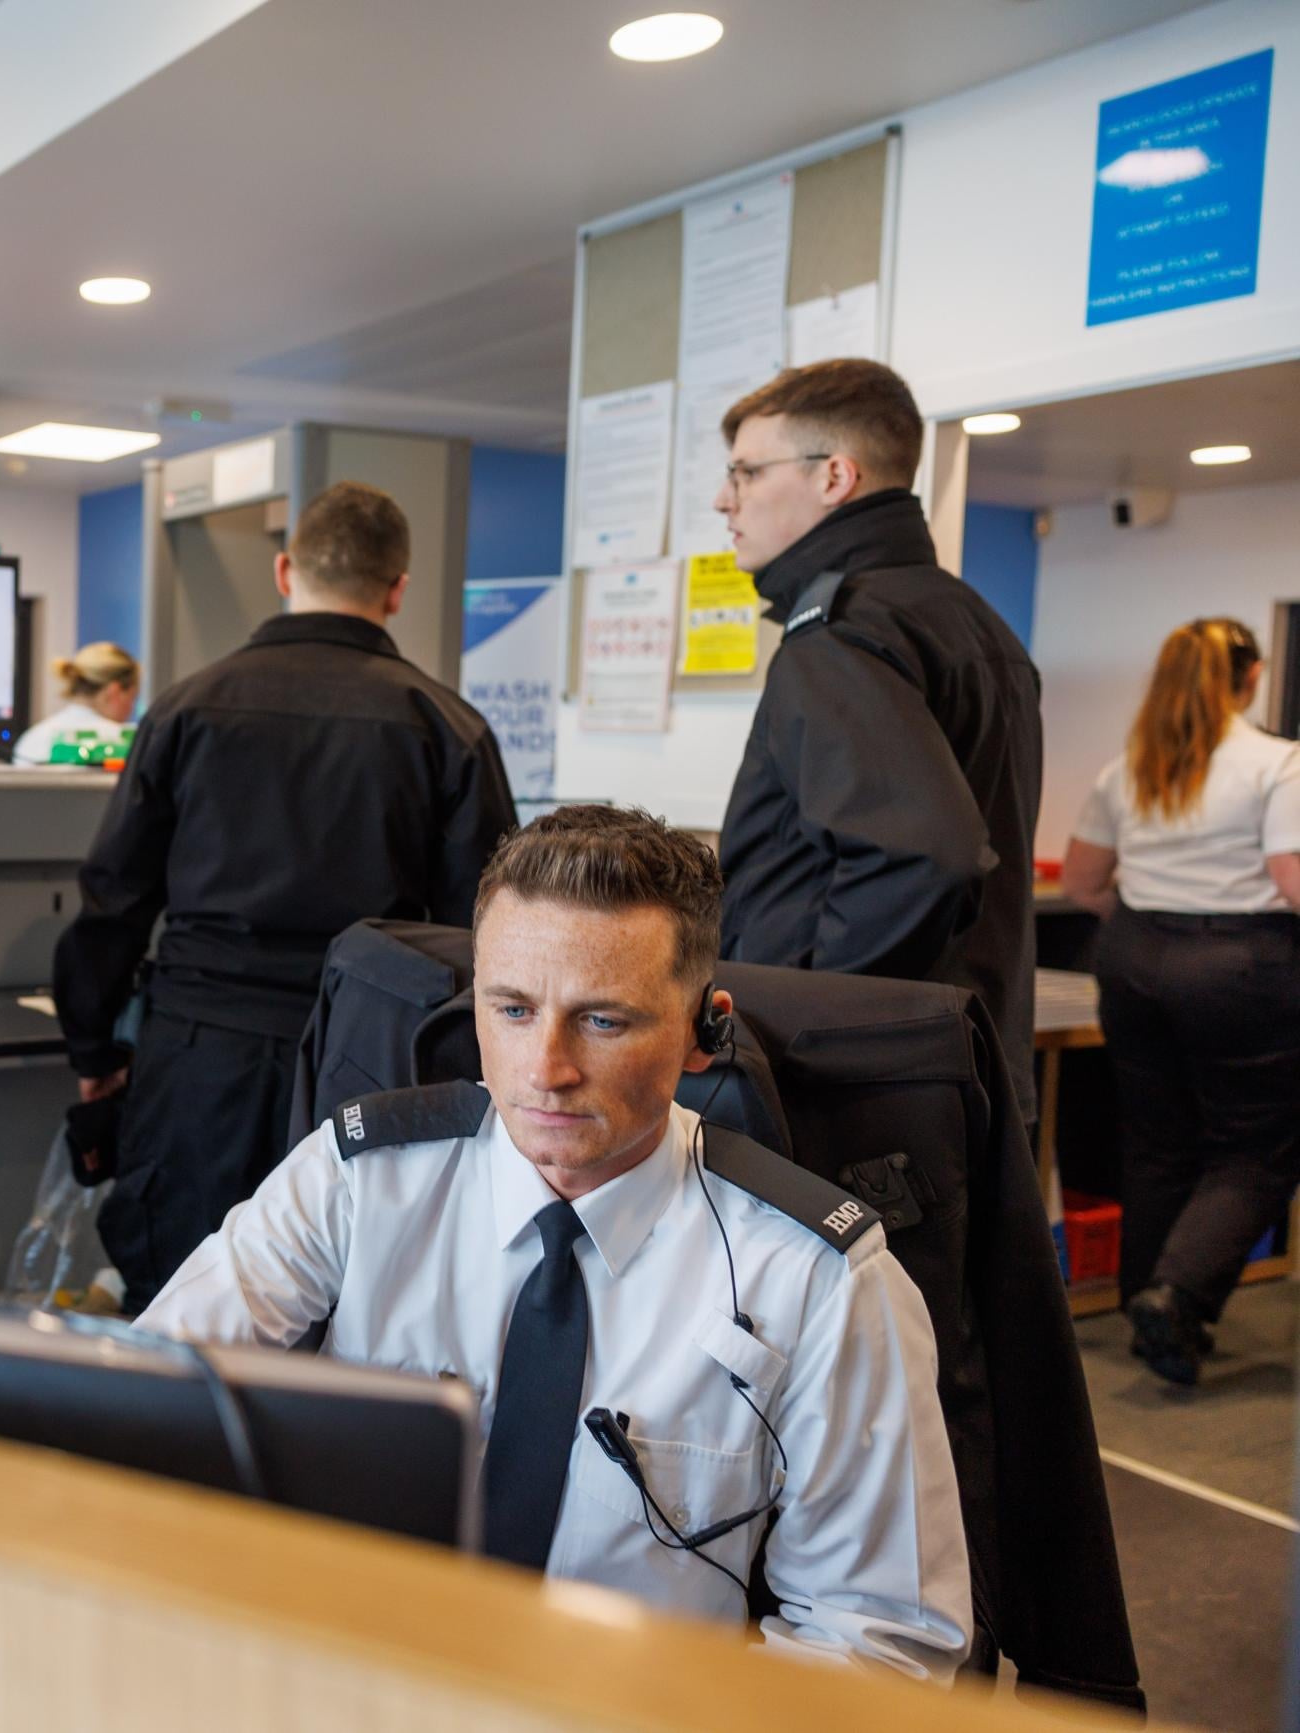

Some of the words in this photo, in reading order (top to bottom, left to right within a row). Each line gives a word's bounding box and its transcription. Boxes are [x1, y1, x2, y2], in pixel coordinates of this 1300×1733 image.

[468, 681, 552, 701] WASH
[343, 1103, 365, 1141] HMP
[822, 1200, 865, 1236] HMP
